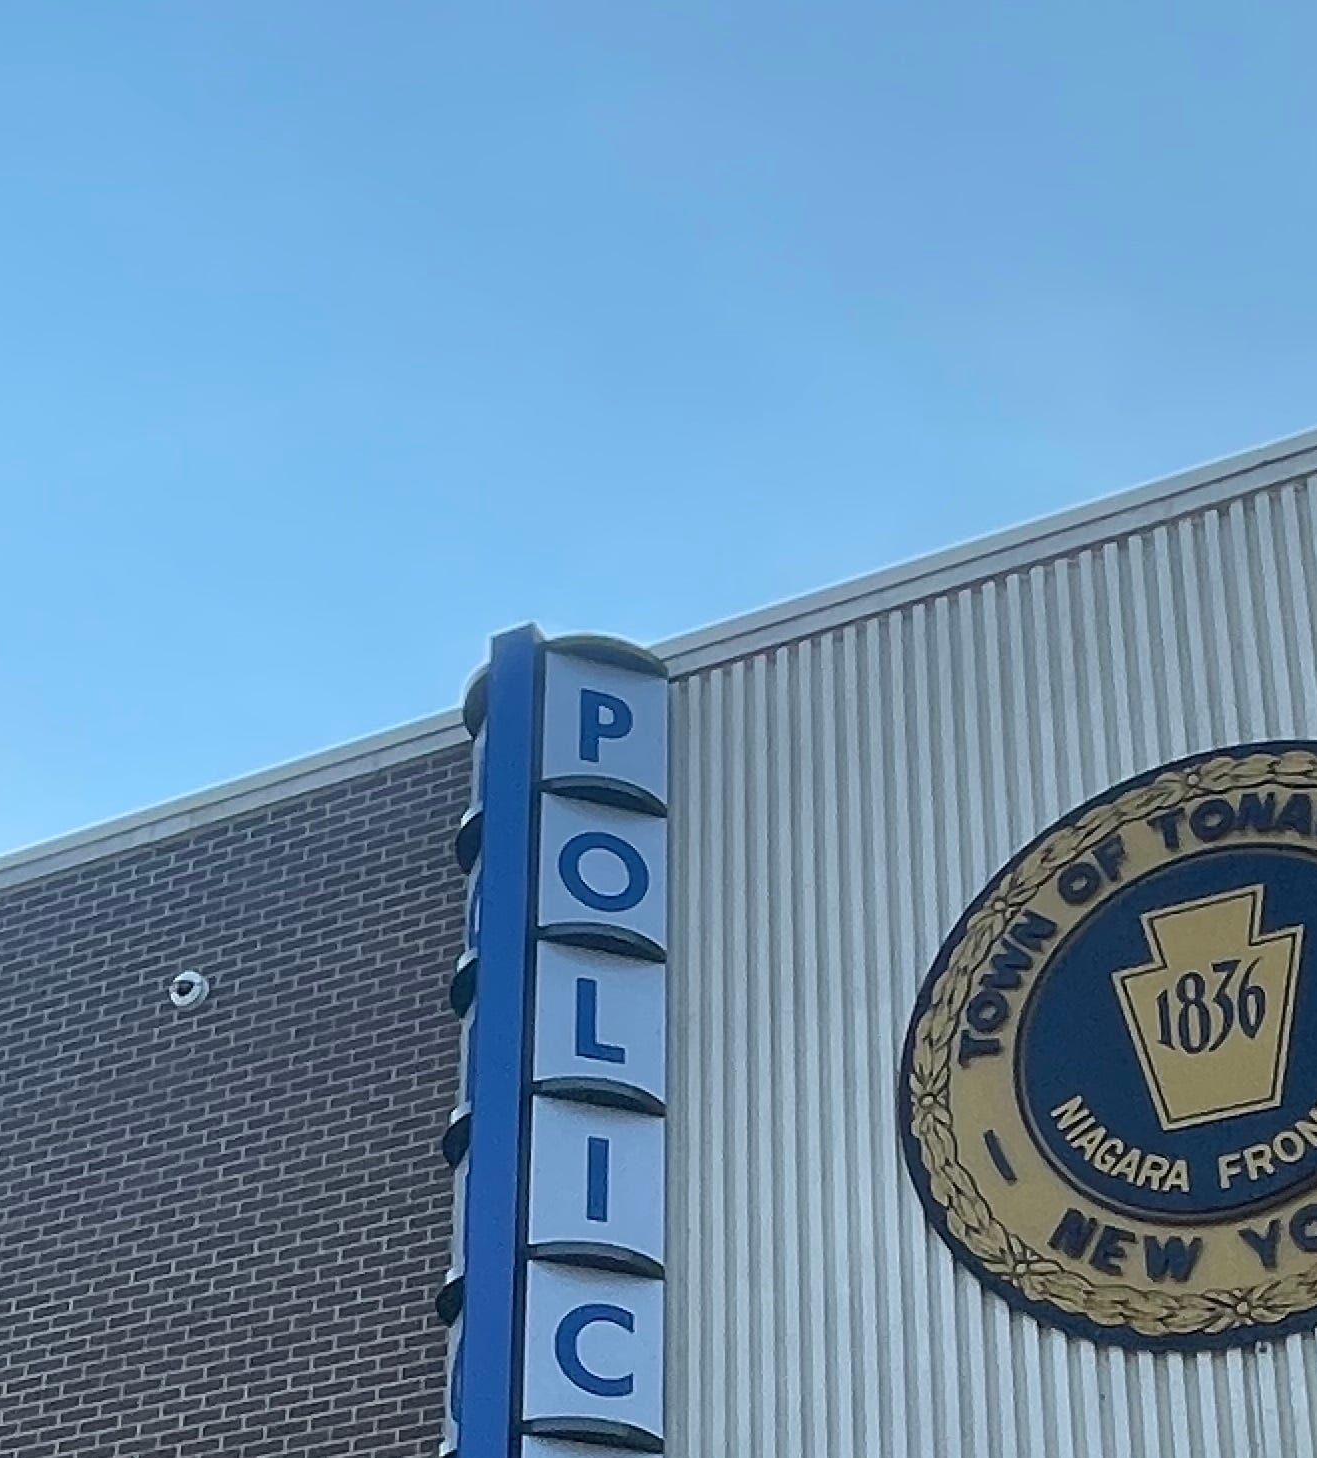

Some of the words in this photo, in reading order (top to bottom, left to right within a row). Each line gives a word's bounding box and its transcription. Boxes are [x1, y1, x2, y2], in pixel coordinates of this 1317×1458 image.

[959, 914, 1058, 1069] TOWN
[1054, 837, 1128, 908] OF
[1155, 957, 1268, 1055] 1836
[1050, 1094, 1190, 1193] NIAGARA
[1047, 1207, 1204, 1283] NEW
